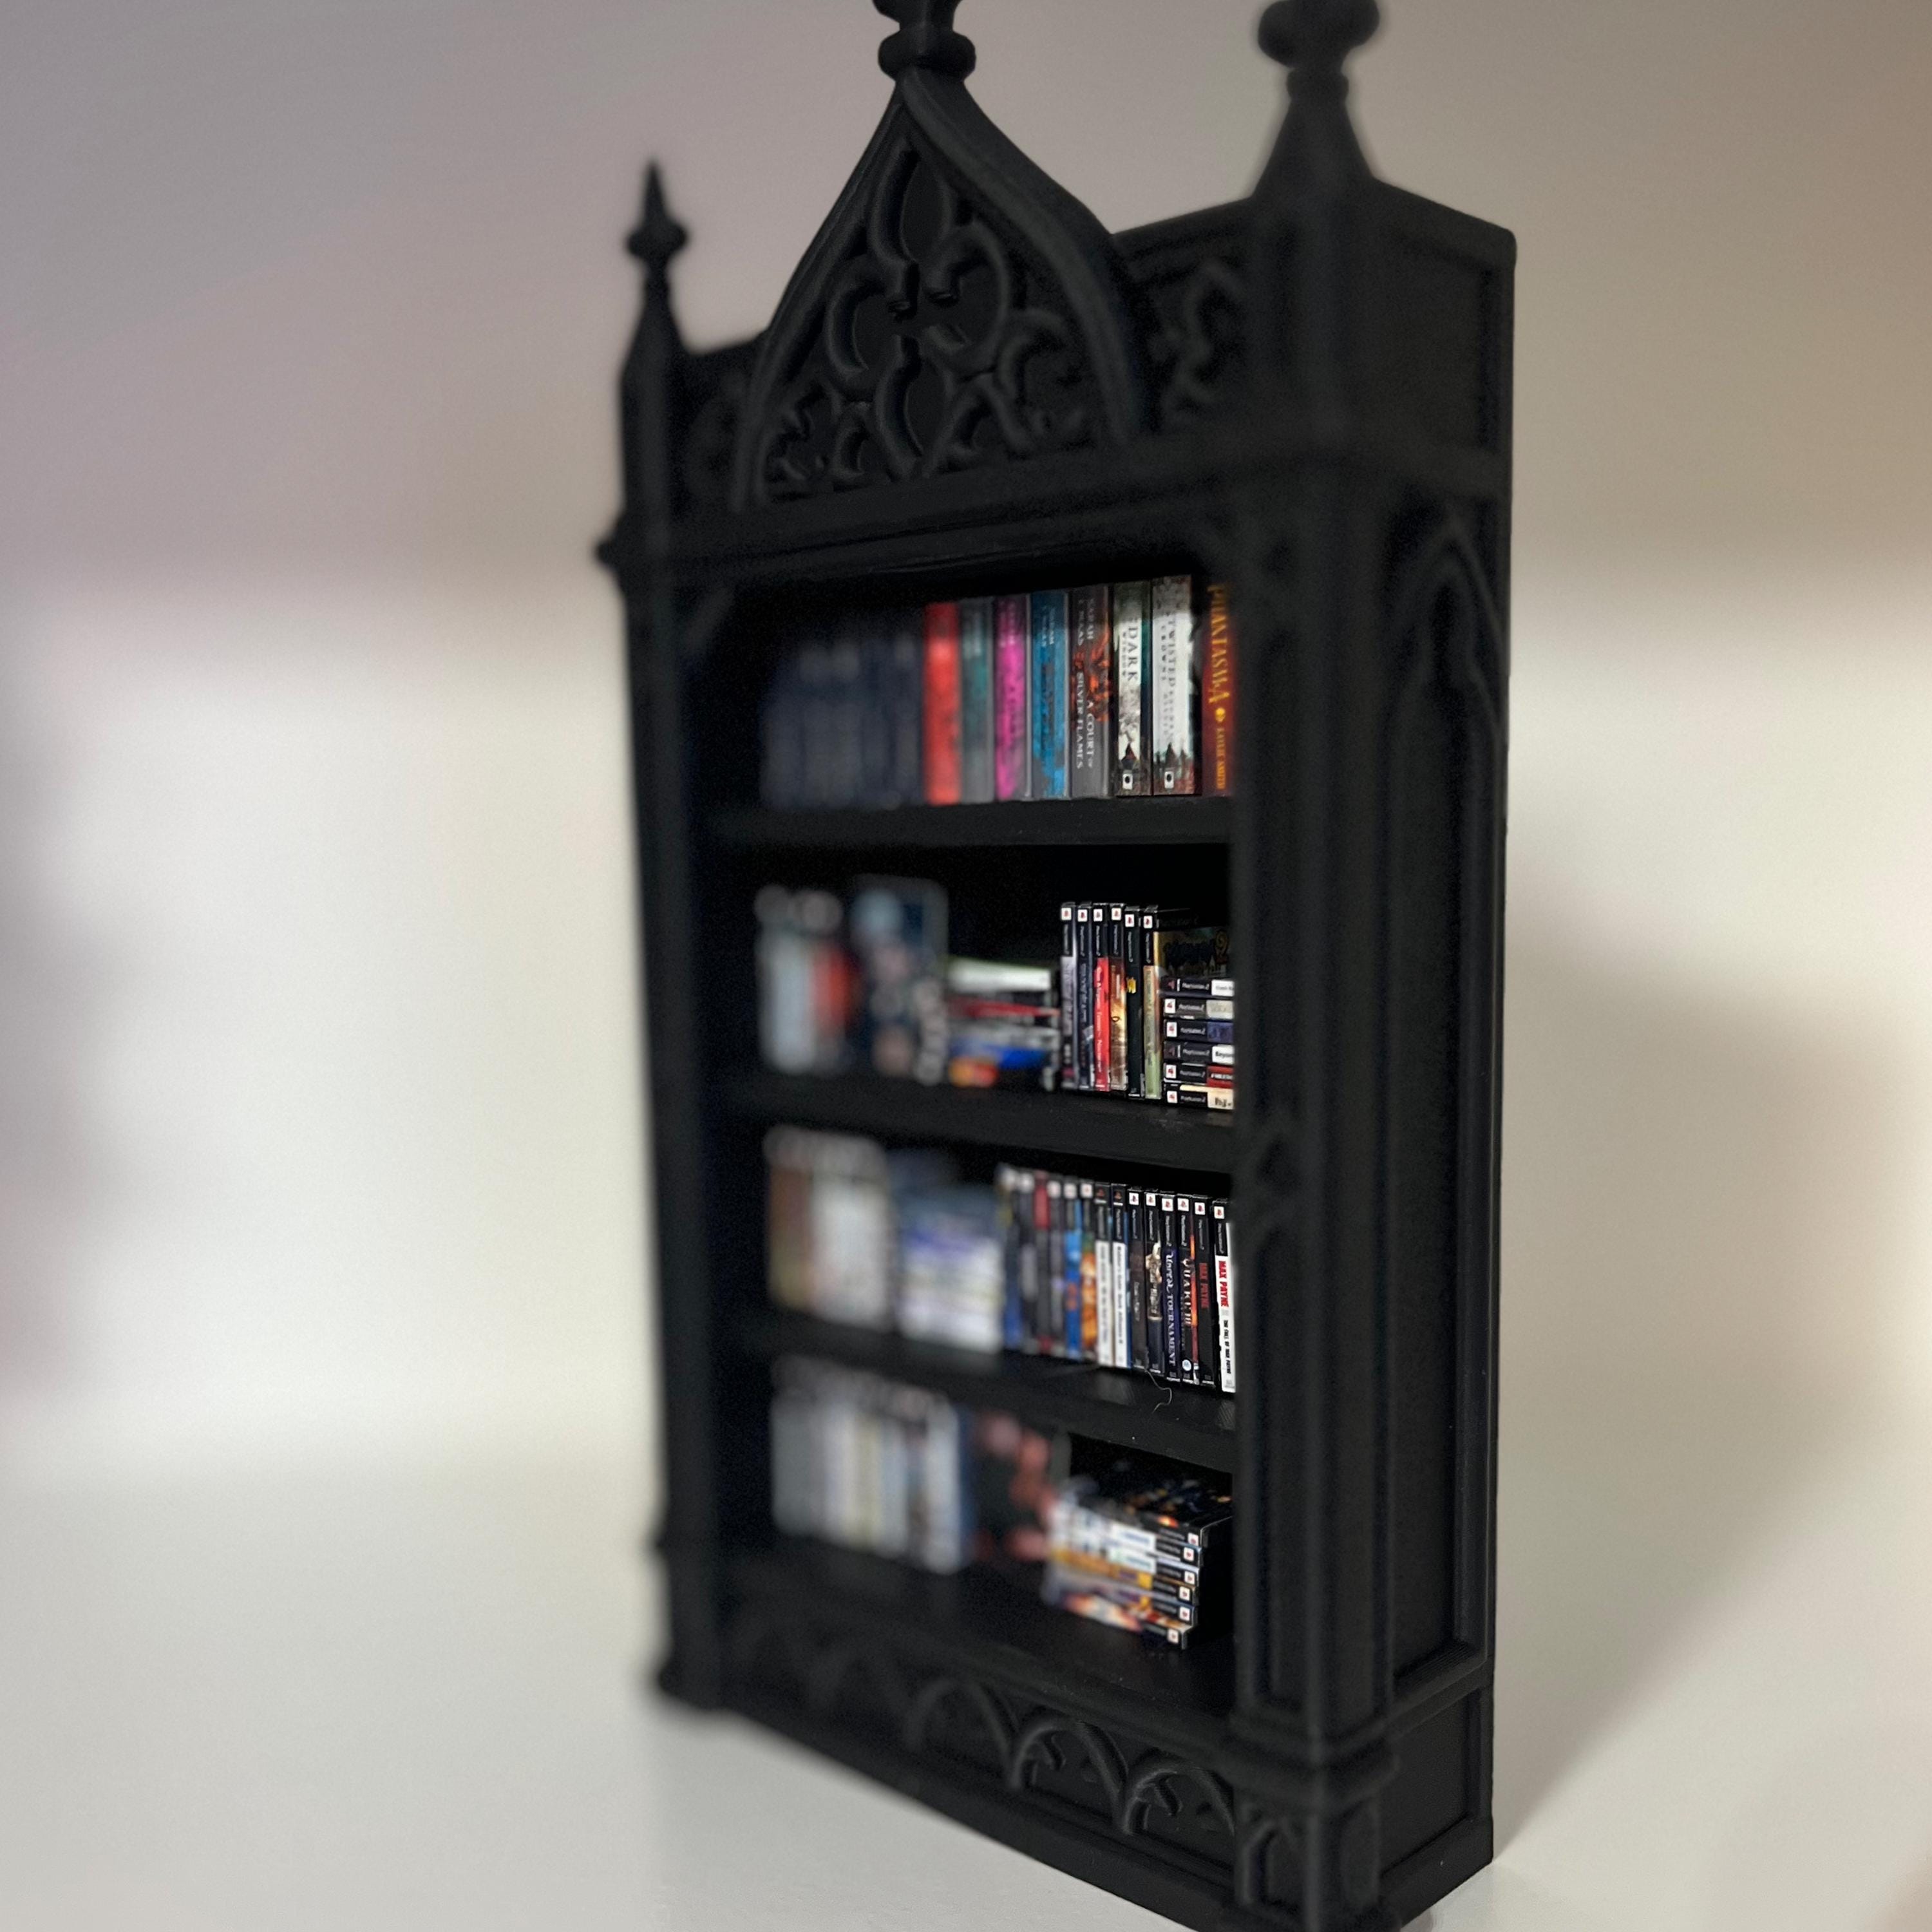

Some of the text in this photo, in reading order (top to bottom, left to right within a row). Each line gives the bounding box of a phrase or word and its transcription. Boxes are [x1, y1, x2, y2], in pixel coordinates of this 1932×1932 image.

[1128, 627, 1139, 681] DARK
[1168, 620, 1176, 687] TWISTED
[1206, 584, 1229, 704] PHANTASMA
[1086, 699, 1094, 709] A
[1086, 713, 1095, 755] COURT
[1198, 1262, 1209, 1309] MAX PAYNE
[1218, 1261, 1227, 1278] MAX
[1220, 1281, 1229, 1307] PAYNE
[1166, 1294, 1177, 1367] TOURNAMENT
